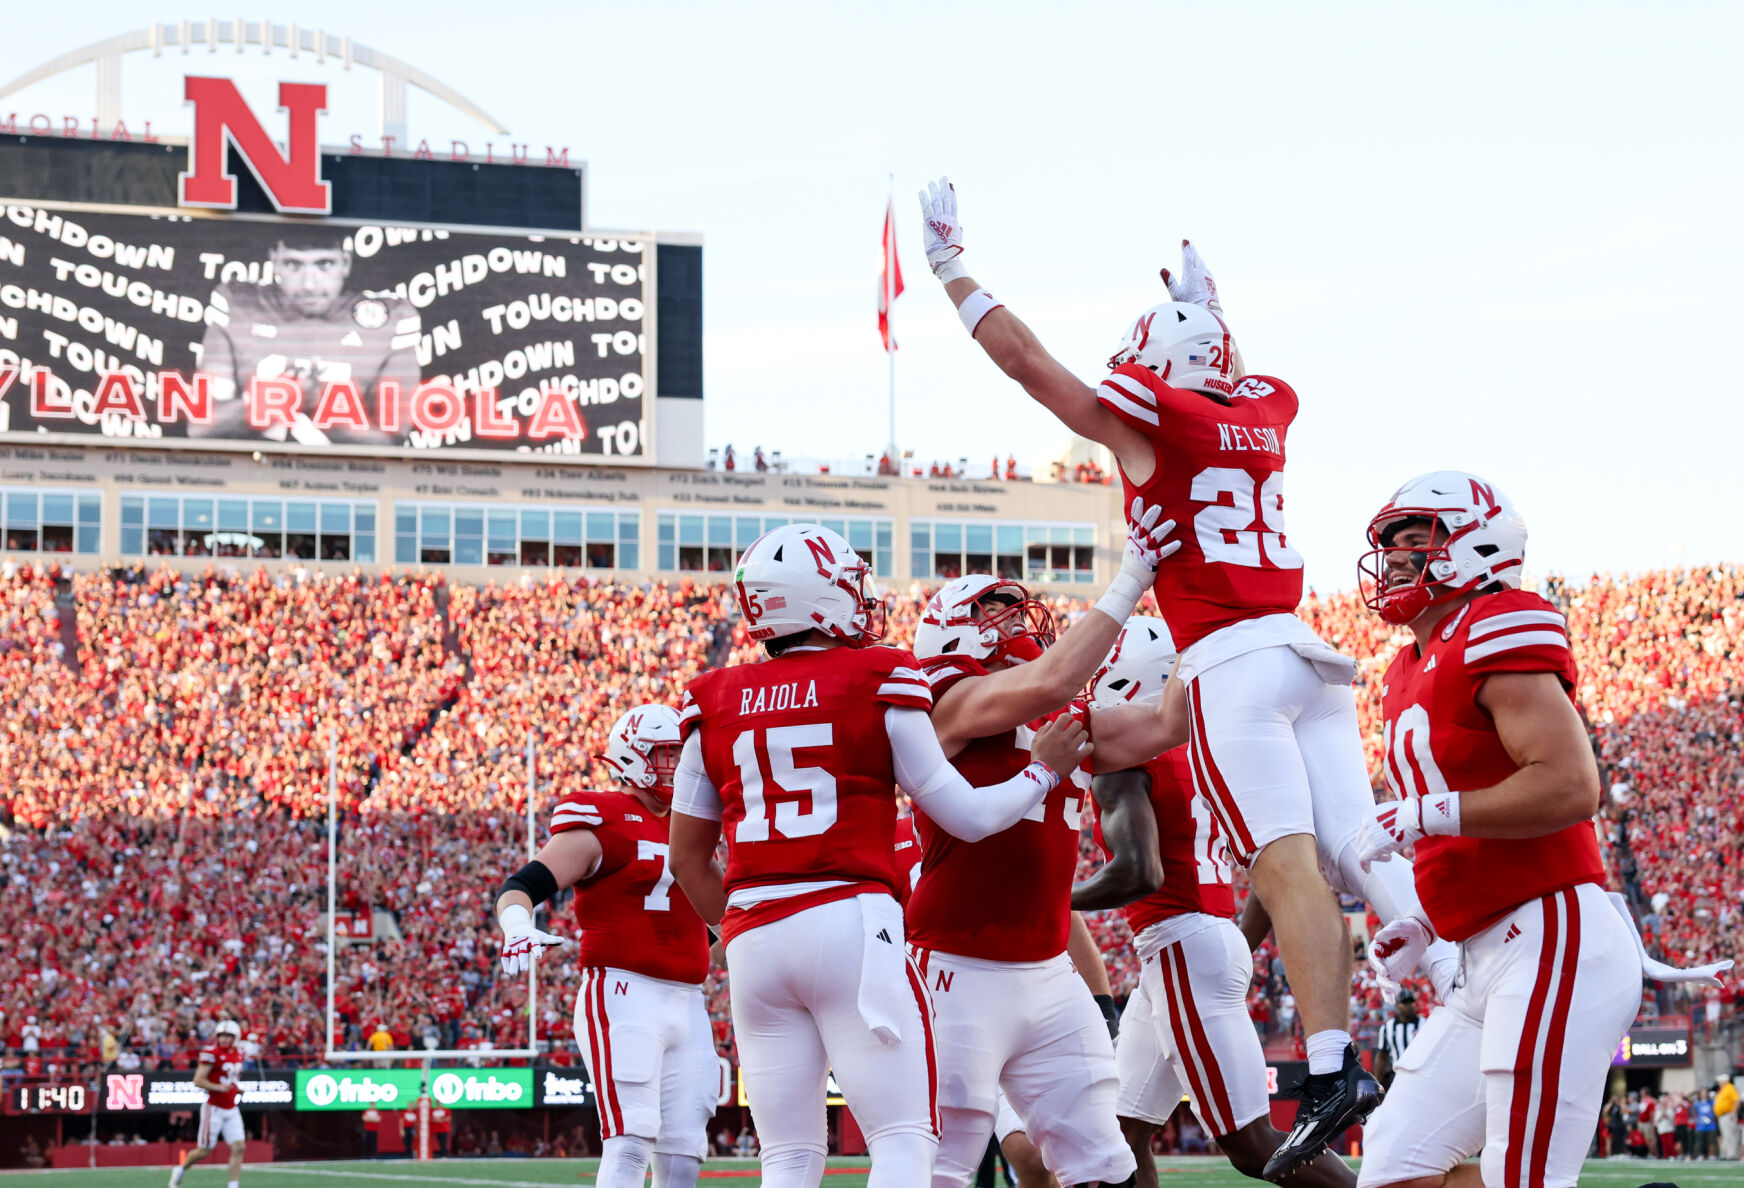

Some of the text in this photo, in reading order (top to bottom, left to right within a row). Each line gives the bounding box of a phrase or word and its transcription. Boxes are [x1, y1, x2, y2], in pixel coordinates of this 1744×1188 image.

[178, 74, 332, 215] N
[349, 134, 570, 168] STADIUM
[0, 203, 175, 271] CHDOWN
[1133, 312, 1156, 340] N
[251, 376, 585, 439] RAIOLA
[1216, 422, 1281, 455] NELSON
[1468, 479, 1496, 510] N
[1190, 467, 1304, 569] 29
[804, 536, 836, 572] N
[739, 679, 819, 716] RAIOLA
[621, 714, 644, 742] N
[732, 723, 838, 843] 15
[637, 840, 676, 912] 7
[615, 981, 628, 996] N
[936, 970, 954, 992] N
[106, 1074, 145, 1110] N
